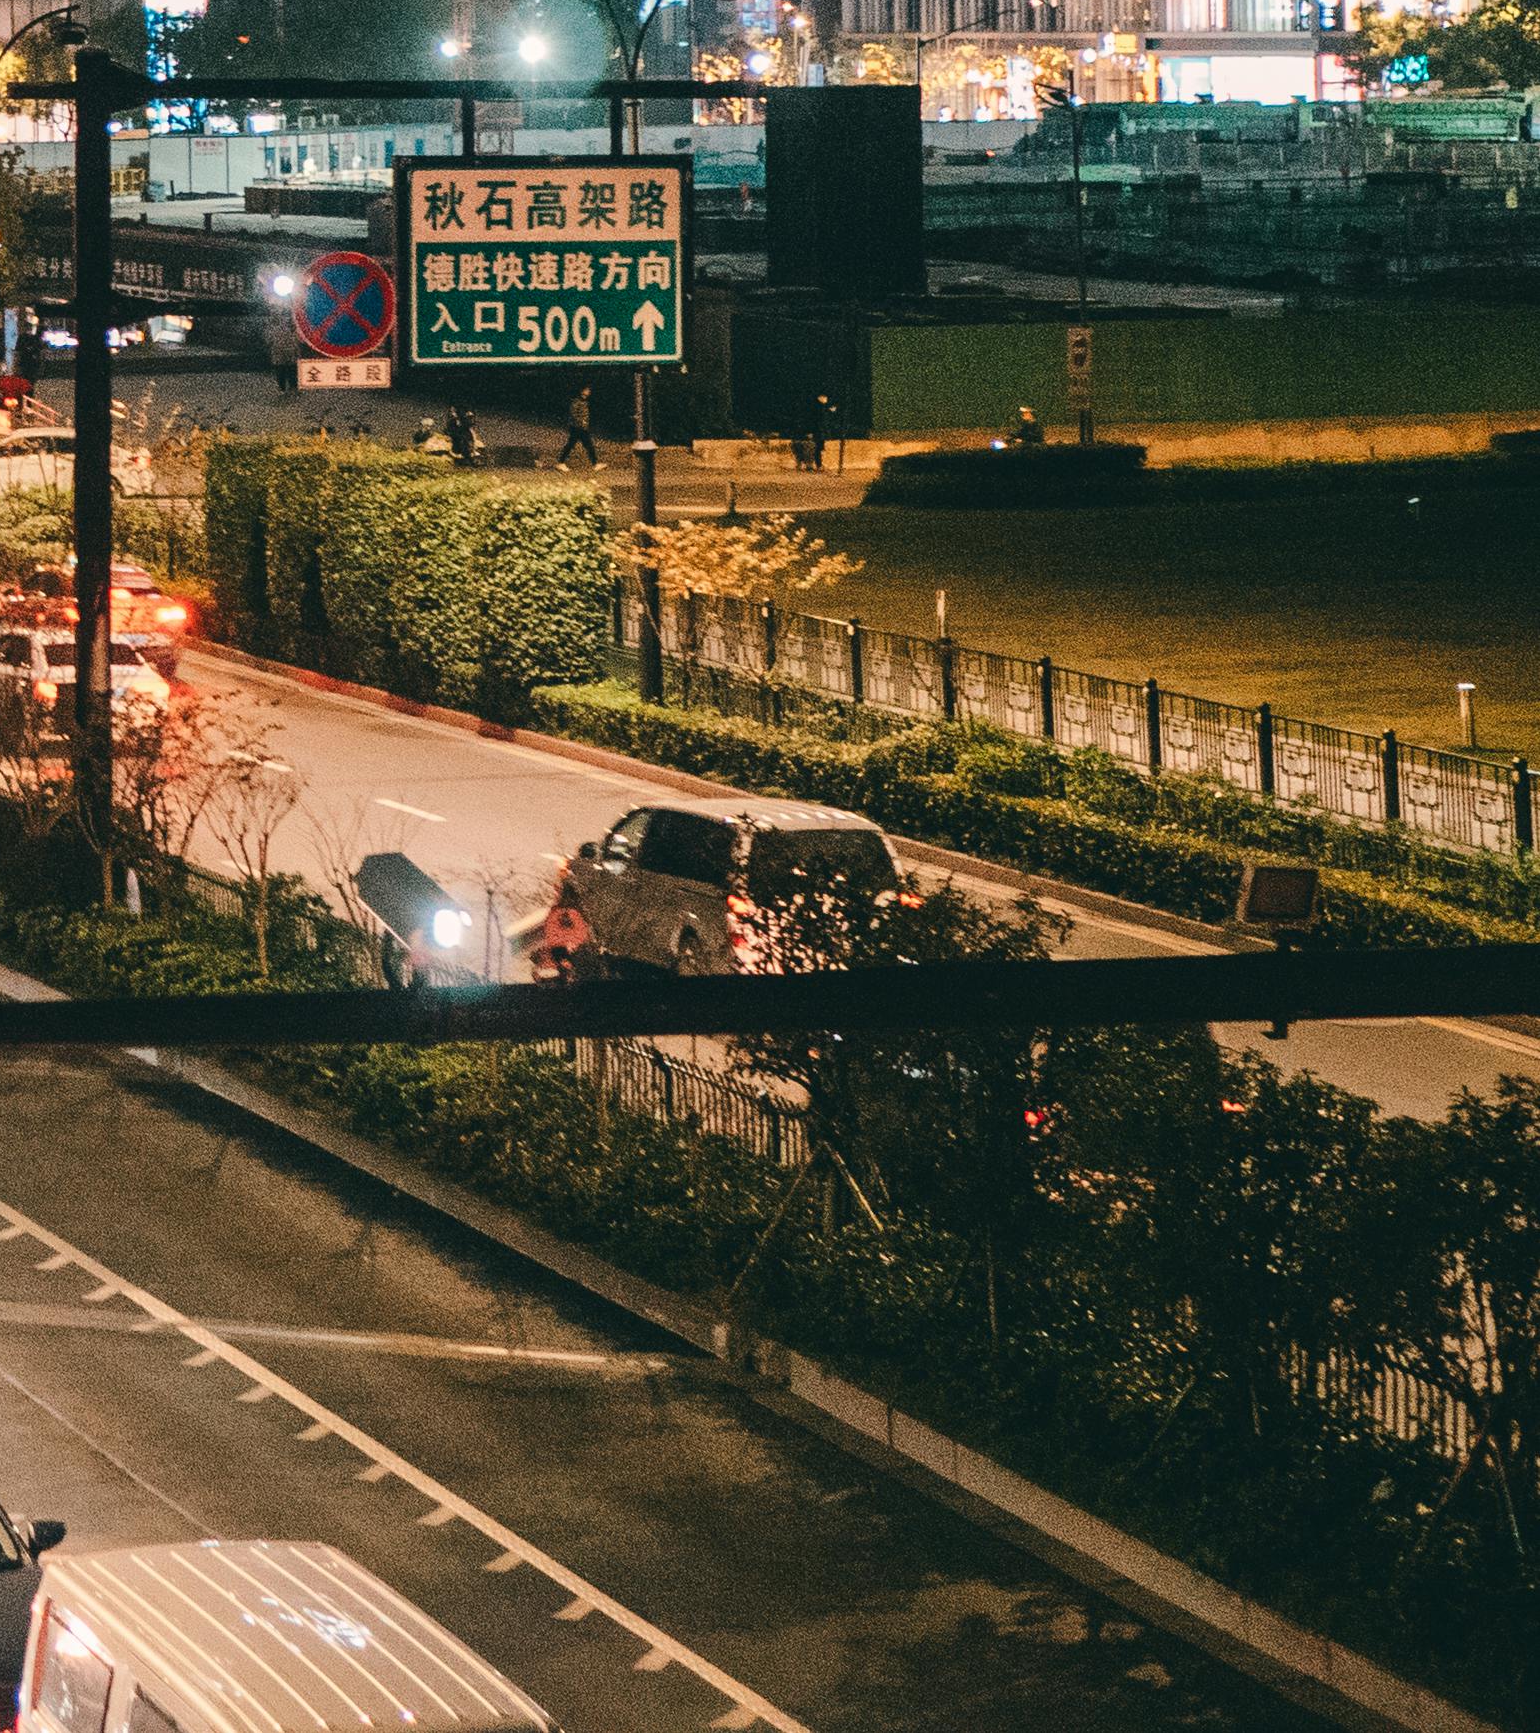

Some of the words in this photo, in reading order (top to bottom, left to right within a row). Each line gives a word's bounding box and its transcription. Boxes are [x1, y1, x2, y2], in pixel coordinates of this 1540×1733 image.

[423, 179, 669, 232] 秋石高架路
[422, 250, 672, 293] 德胜快速路方向
[429, 301, 507, 334] 入口
[517, 304, 621, 352] 500m
[441, 339, 494, 354] Entrance
